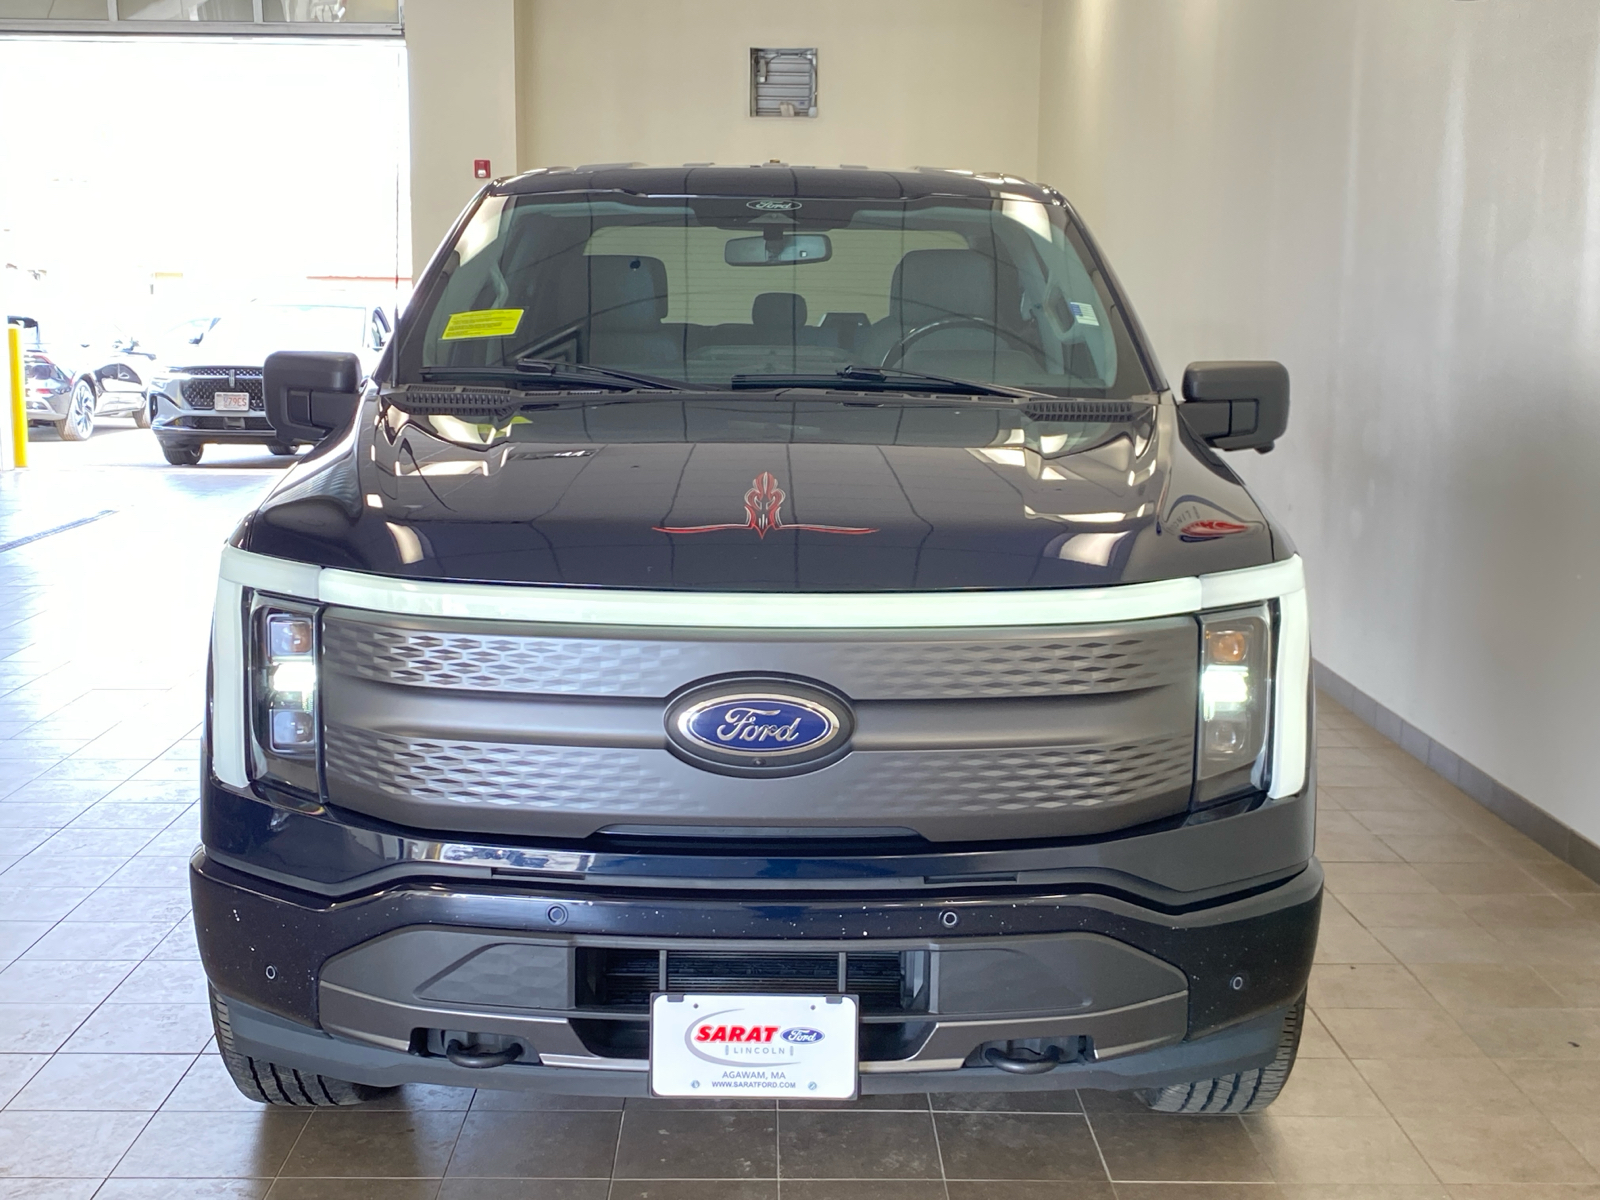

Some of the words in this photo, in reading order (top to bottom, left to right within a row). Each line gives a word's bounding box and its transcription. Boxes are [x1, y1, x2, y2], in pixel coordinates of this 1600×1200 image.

[755, 200, 793, 210] Ford
[716, 707, 802, 742] Ford
[696, 1025, 779, 1043] SARAT
[787, 1029, 817, 1042] Ford
[733, 1046, 786, 1055] LINCOLN
[722, 1070, 768, 1080] AGAWAM,
[770, 1071, 786, 1080] MA
[711, 1081, 796, 1089] WWW.SARATFORD.COM
